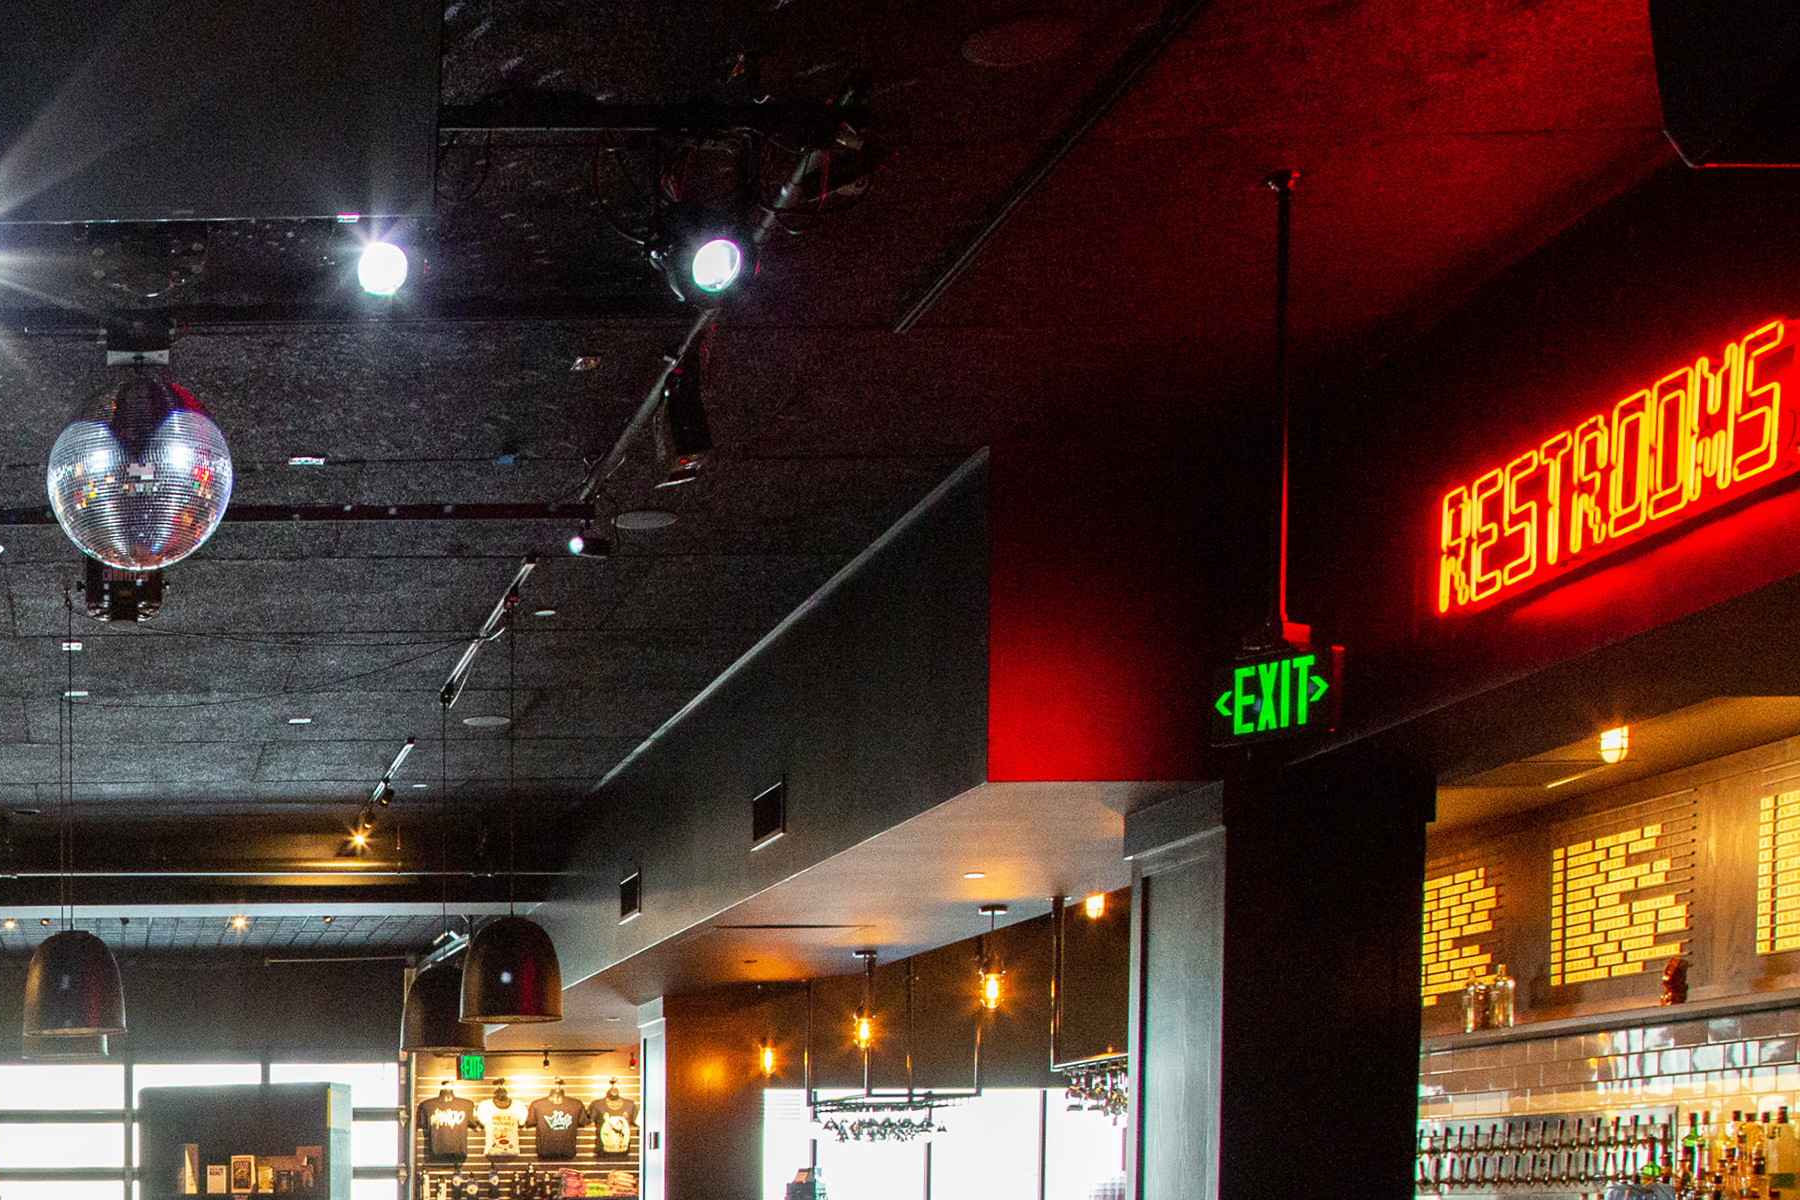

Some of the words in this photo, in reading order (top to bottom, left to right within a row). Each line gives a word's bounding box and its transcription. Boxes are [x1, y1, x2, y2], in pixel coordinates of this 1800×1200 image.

[1439, 320, 1784, 613] RESTROOMS
[1234, 654, 1315, 736] EXIT
[463, 1055, 482, 1080] EXIT
